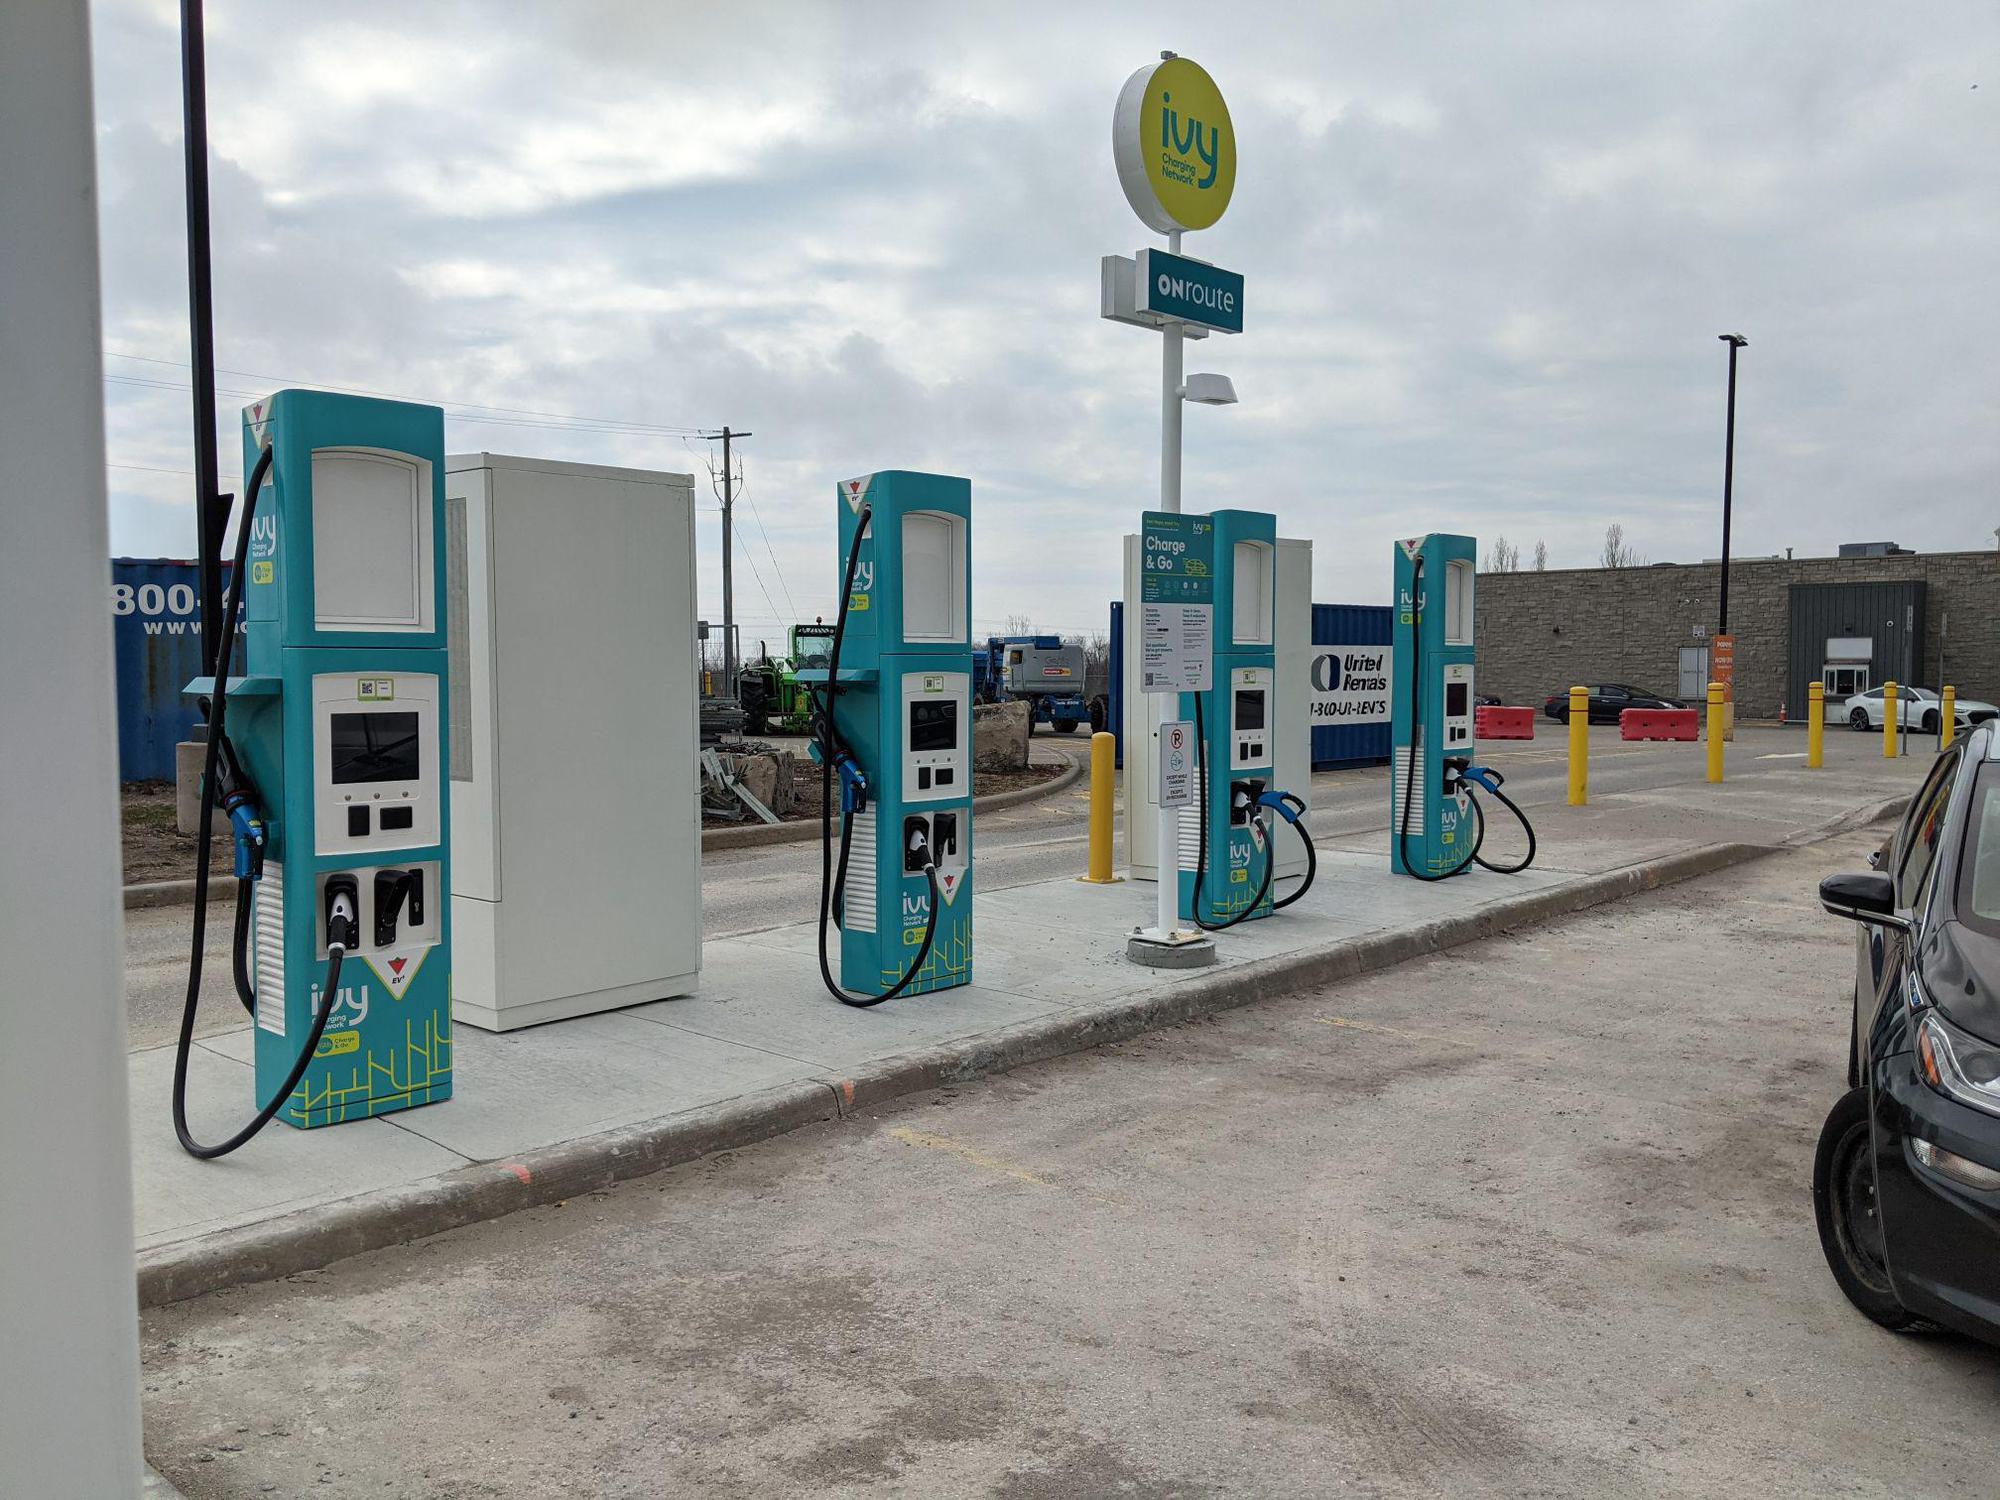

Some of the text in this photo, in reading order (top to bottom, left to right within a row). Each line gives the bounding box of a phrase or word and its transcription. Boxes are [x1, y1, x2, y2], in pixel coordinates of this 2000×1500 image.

[1161, 91, 1218, 189] ivy
[1162, 152, 1196, 177] Charging
[1162, 165, 1194, 186] Network
[1158, 274, 1234, 313] ONroute
[1146, 535, 1186, 555] Charge
[1146, 554, 1173, 569] & Go
[1342, 673, 1387, 692] Rentas
[1441, 809, 1457, 830] ivy
[1229, 840, 1250, 866] ivy
